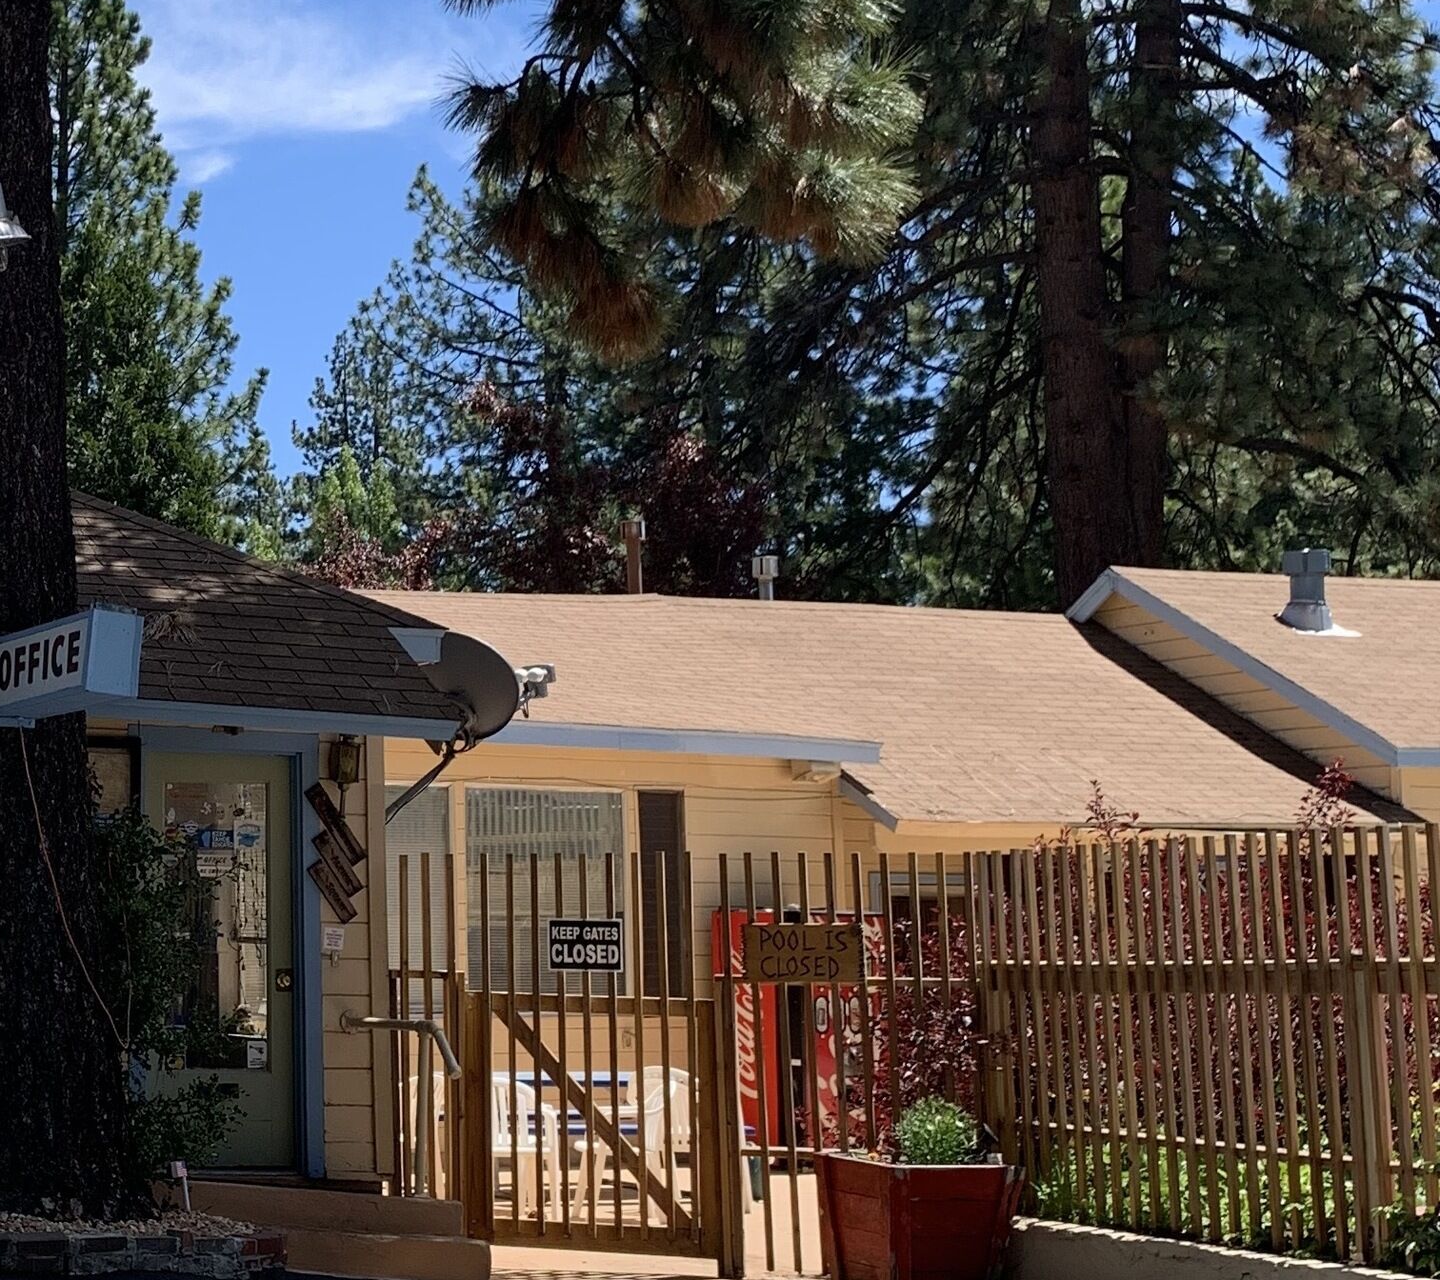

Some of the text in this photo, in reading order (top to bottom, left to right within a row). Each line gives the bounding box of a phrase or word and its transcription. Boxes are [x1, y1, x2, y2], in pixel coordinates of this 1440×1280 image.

[551, 926, 619, 941] KEEP GATES
[759, 927, 848, 952] POOL IS
[551, 943, 620, 964] CLOSED
[760, 956, 840, 979] CLOSED
